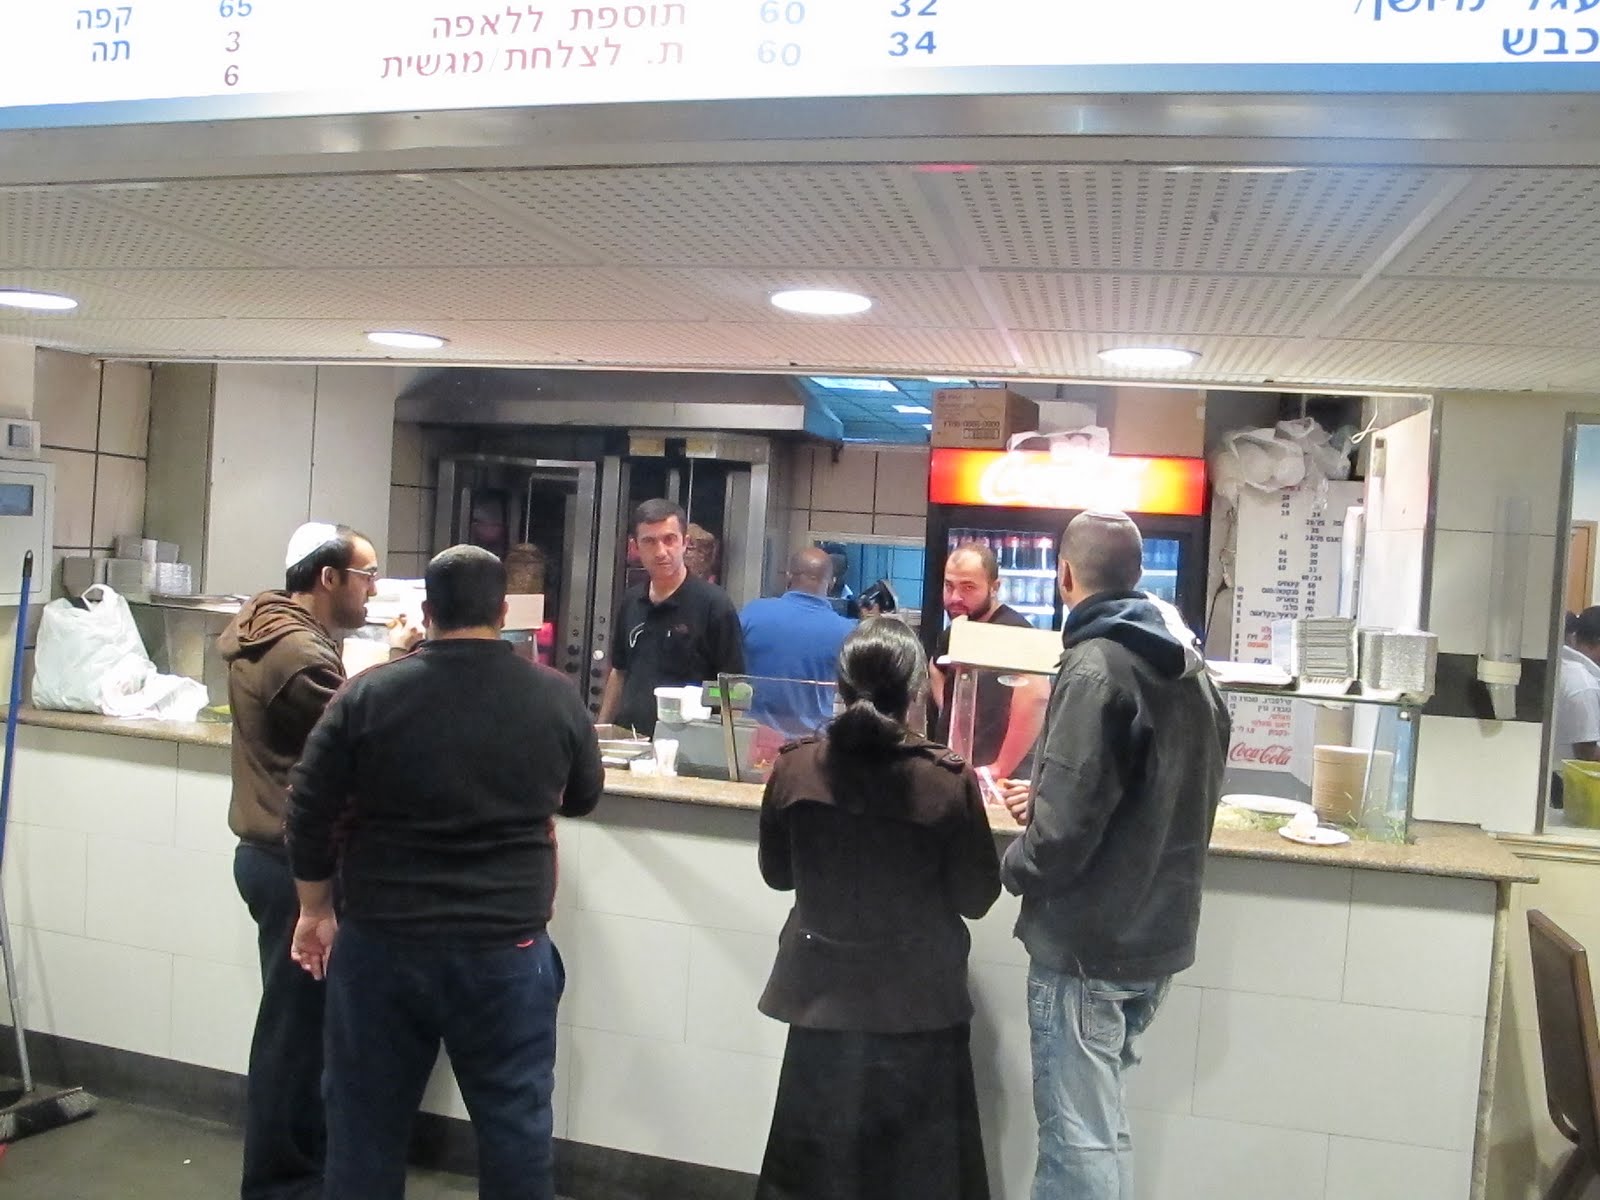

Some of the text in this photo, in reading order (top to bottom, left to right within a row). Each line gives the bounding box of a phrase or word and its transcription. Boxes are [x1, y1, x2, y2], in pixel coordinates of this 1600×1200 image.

[76, 7, 133, 34] קפה
[219, 0, 253, 18] 65
[432, 3, 686, 39] תוספת ללאפה
[760, 0, 806, 25] 60
[890, 0, 938, 18] 32
[92, 40, 131, 62] תה
[225, 31, 241, 52] 3
[647, 40, 684, 66] ת.
[757, 40, 802, 67] 60
[888, 31, 937, 57] 34
[1502, 27, 1600, 56] כבש
[224, 64, 239, 87] 6
[1230, 741, 1293, 765] Coca-Cola
